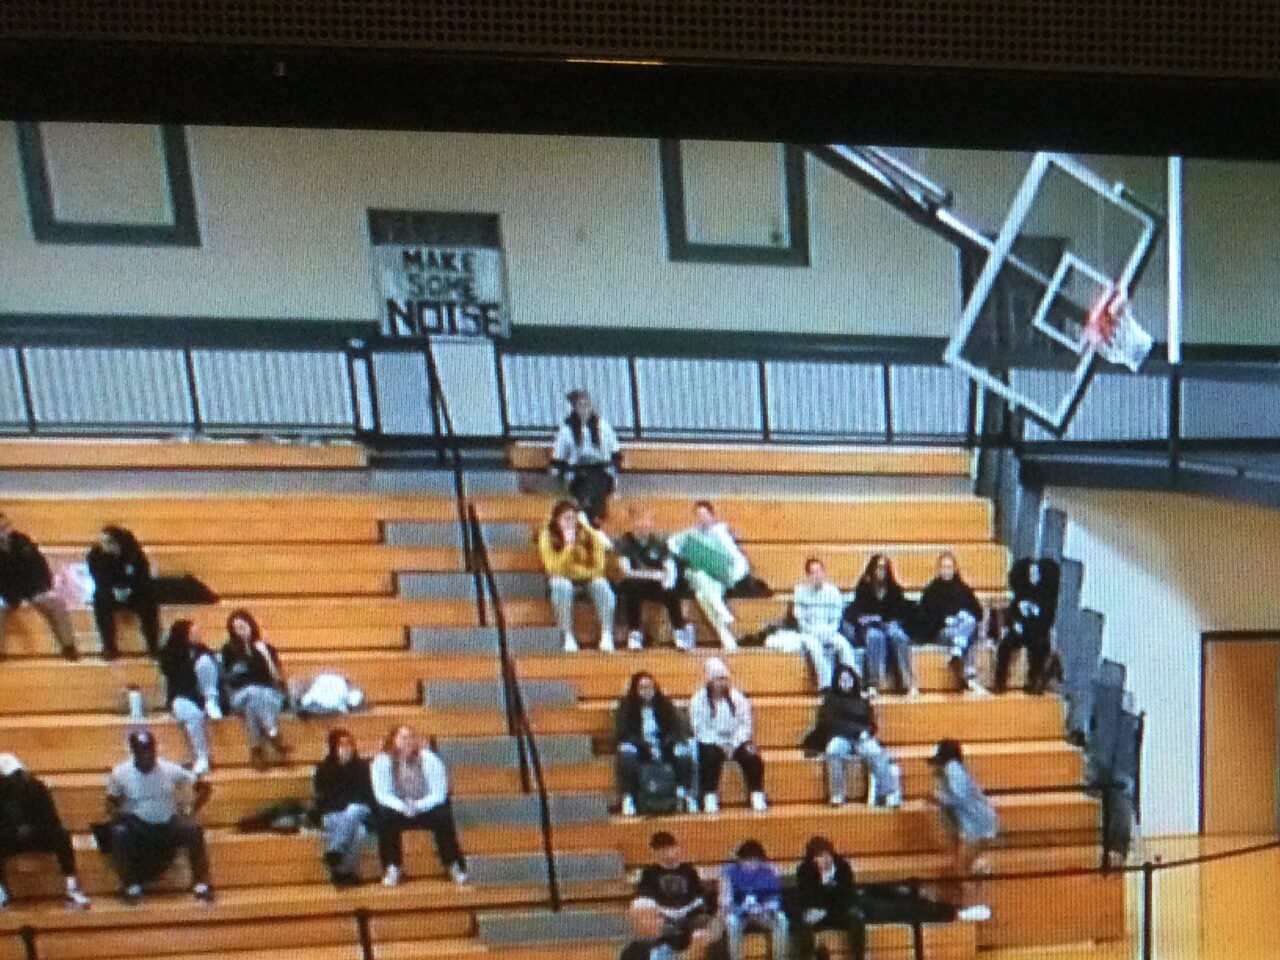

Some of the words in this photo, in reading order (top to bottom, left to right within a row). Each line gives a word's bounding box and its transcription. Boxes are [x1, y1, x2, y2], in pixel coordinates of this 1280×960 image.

[402, 249, 475, 274] MAKE
[407, 274, 478, 302] SOME
[387, 298, 501, 337] NOISE
